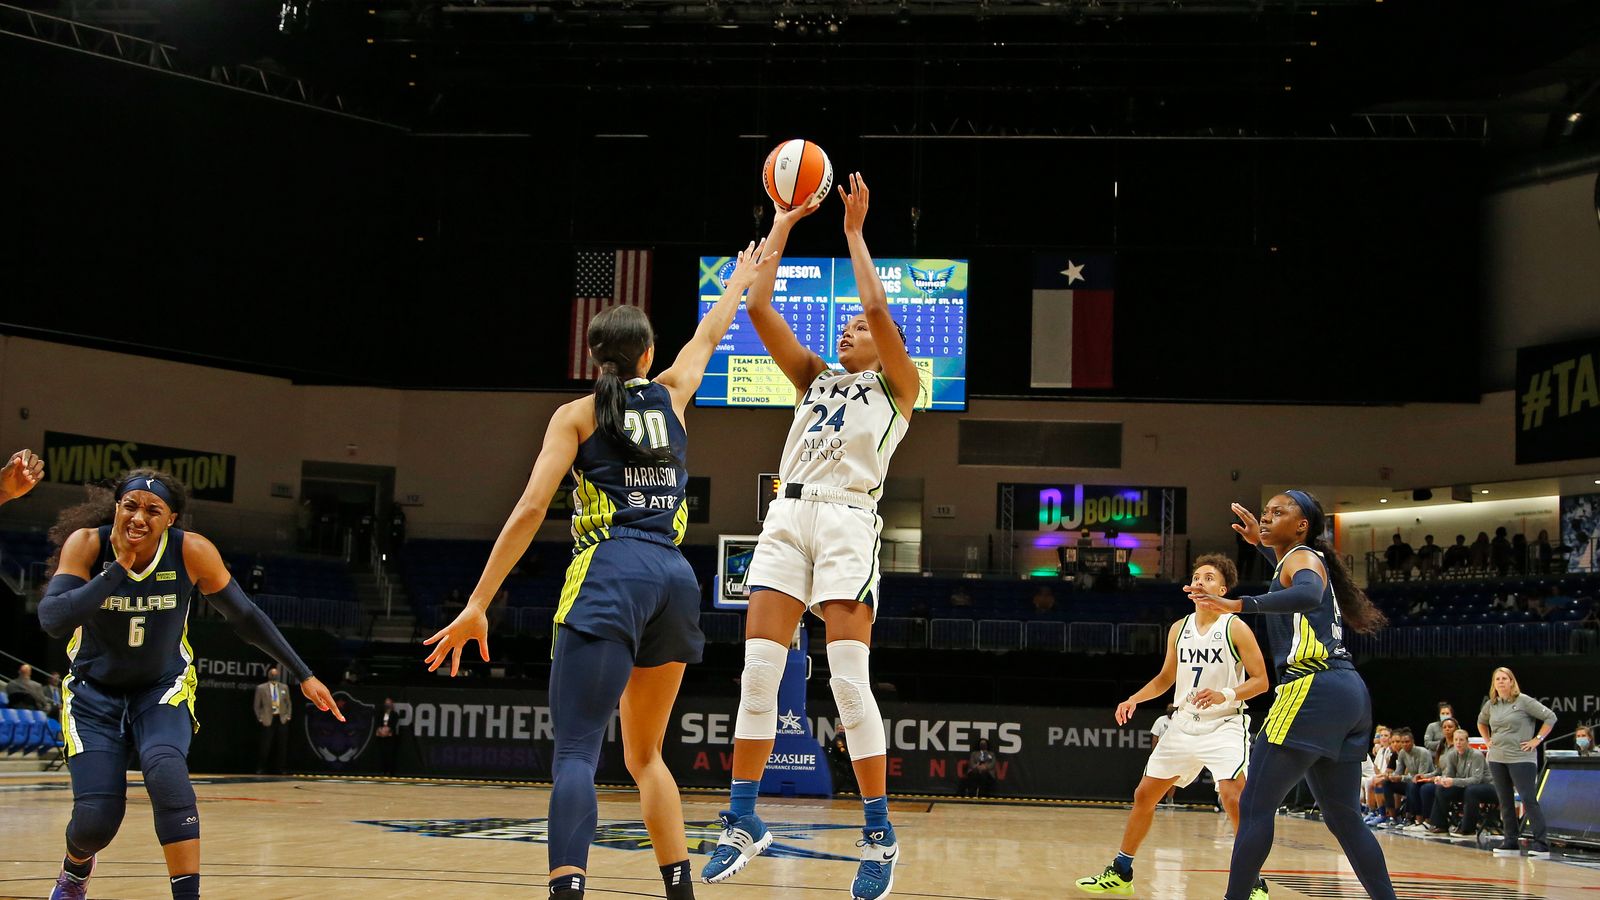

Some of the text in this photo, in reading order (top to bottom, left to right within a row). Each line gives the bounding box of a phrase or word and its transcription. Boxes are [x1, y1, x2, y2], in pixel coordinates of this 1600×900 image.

[776, 266, 821, 278] NNESOTA
[876, 266, 902, 280] LLAS
[1521, 351, 1600, 432] #TA
[808, 403, 846, 432] 24
[48, 442, 138, 481] WINGS
[624, 466, 677, 487] HARRISON
[1039, 484, 1148, 532] DJ BOOTH
[128, 616, 146, 648] 6
[1180, 648, 1223, 663] LYNX
[199, 657, 272, 677] FIDELITY
[1192, 667, 1203, 688] 7
[883, 718, 1022, 754] ICKETS
[1048, 726, 1152, 749] PANTHE
[768, 753, 816, 765] EXASLIFE
